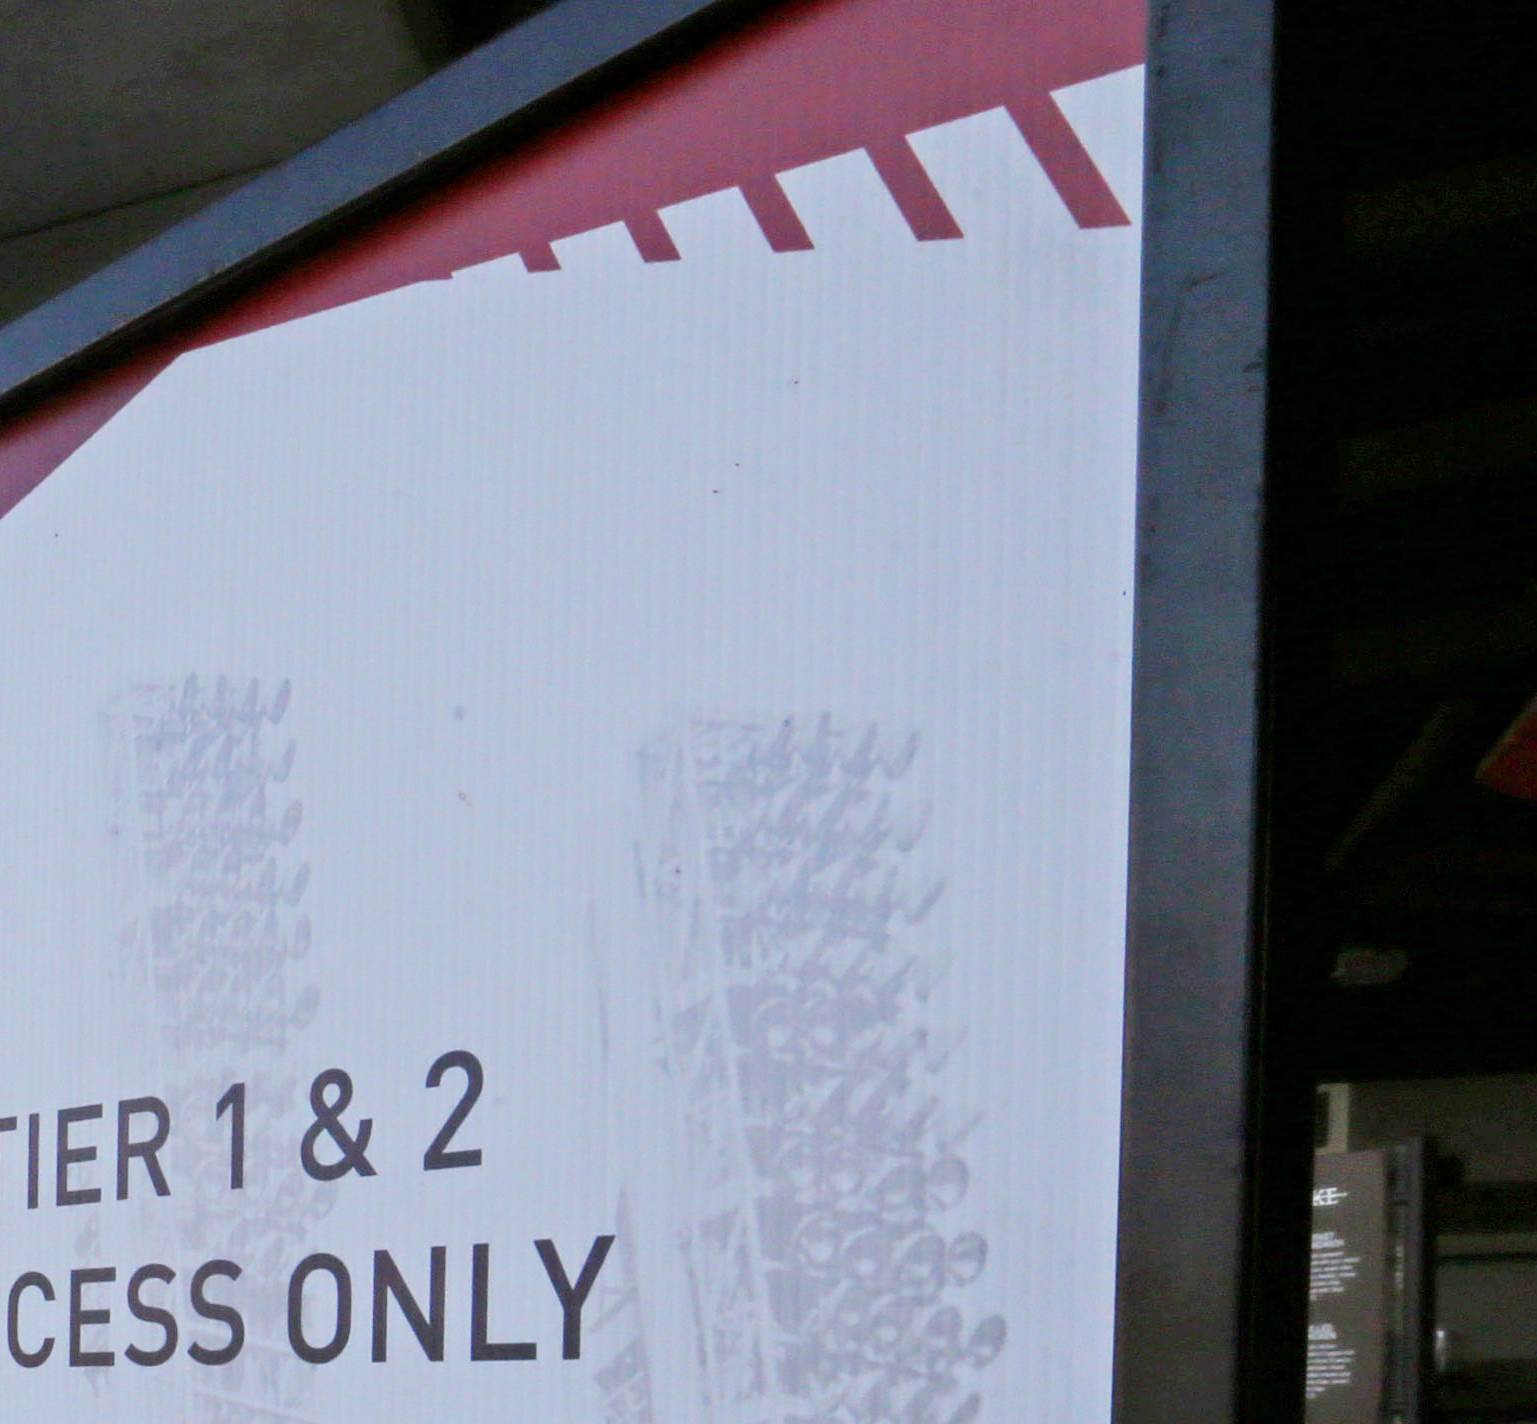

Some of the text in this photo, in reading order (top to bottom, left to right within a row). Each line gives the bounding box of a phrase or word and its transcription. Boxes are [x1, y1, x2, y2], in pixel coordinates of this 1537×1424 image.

[215, 1082, 246, 1190] 1
[300, 1068, 377, 1182] &
[423, 1050, 485, 1171] 2
[287, 1234, 617, 1366] ONLY
